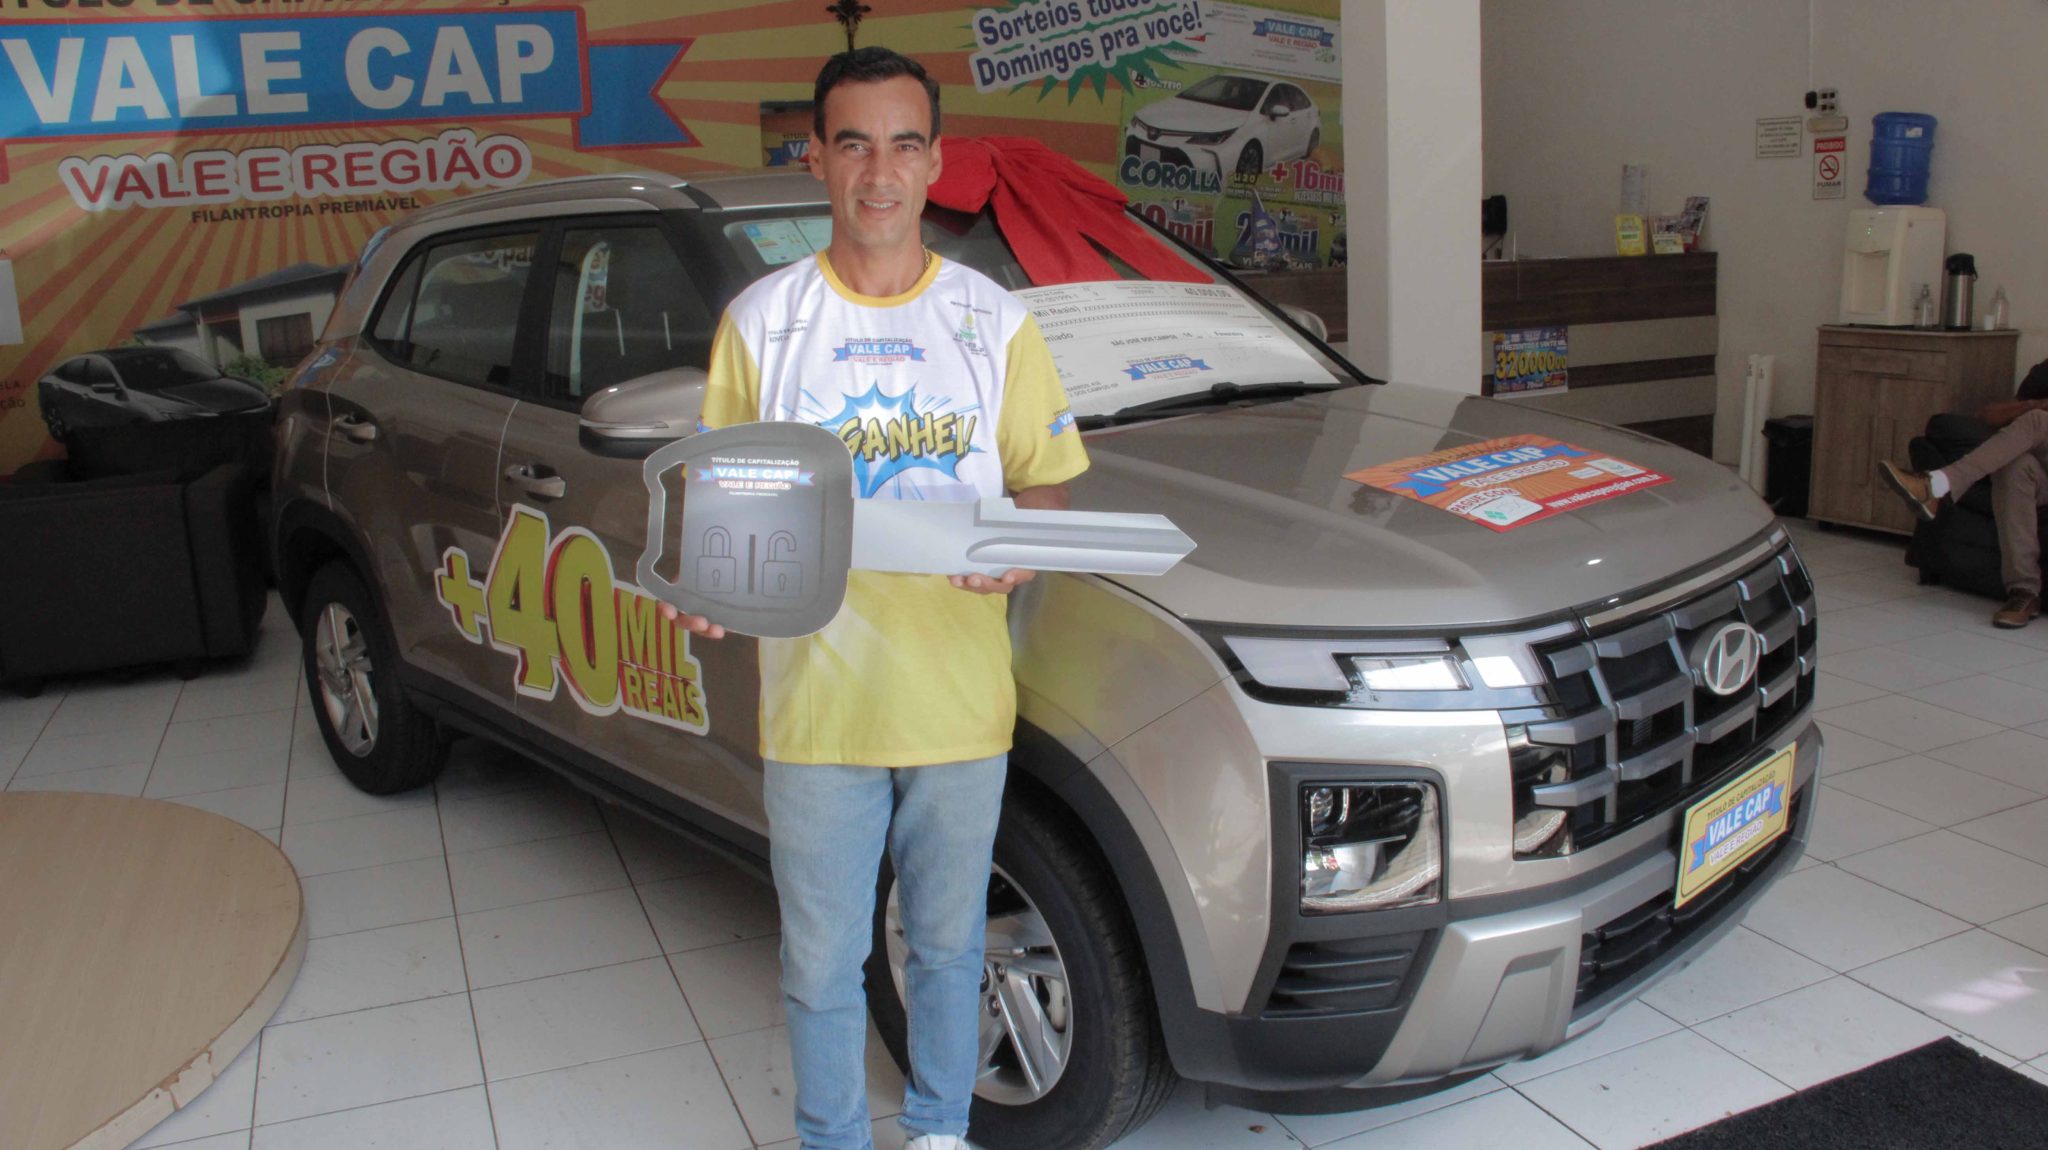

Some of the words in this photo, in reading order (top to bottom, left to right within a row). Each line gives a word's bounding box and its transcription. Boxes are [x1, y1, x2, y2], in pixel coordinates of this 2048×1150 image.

[979, 0, 1081, 45] Sorteios
[1266, 21, 1297, 36] VALE
[1298, 27, 1323, 40] CAP
[976, 38, 1094, 86] Domingos
[1100, 24, 1139, 60] pra
[1144, 1, 1203, 41] você!
[2, 34, 308, 124] VALE
[344, 23, 554, 110] CAP
[70, 157, 231, 205] VALE
[248, 155, 281, 194] E
[302, 137, 523, 191] REGIÃO
[1121, 155, 1223, 194] COROLLA
[1293, 160, 1344, 193] 16mi
[191, 205, 314, 224] FILANTROPIA
[320, 197, 421, 215] PREMIÁVEL
[849, 343, 880, 355] VALE
[884, 343, 910, 355] CAP
[1043, 332, 1074, 343] miado
[1136, 360, 1170, 374] VALE
[1169, 357, 1193, 371] CAP
[838, 411, 977, 464] GANHEI!
[716, 467, 758, 479] VALE
[762, 468, 794, 480] CAP
[747, 457, 800, 467] CAPITALIZAÇÃO
[1413, 457, 1501, 484] VALE
[1490, 446, 1547, 468] CAP
[614, 587, 698, 682] MIL
[621, 664, 706, 728] REAIS
[1708, 806, 1744, 847] VALE
[1745, 786, 1771, 821] CAP
